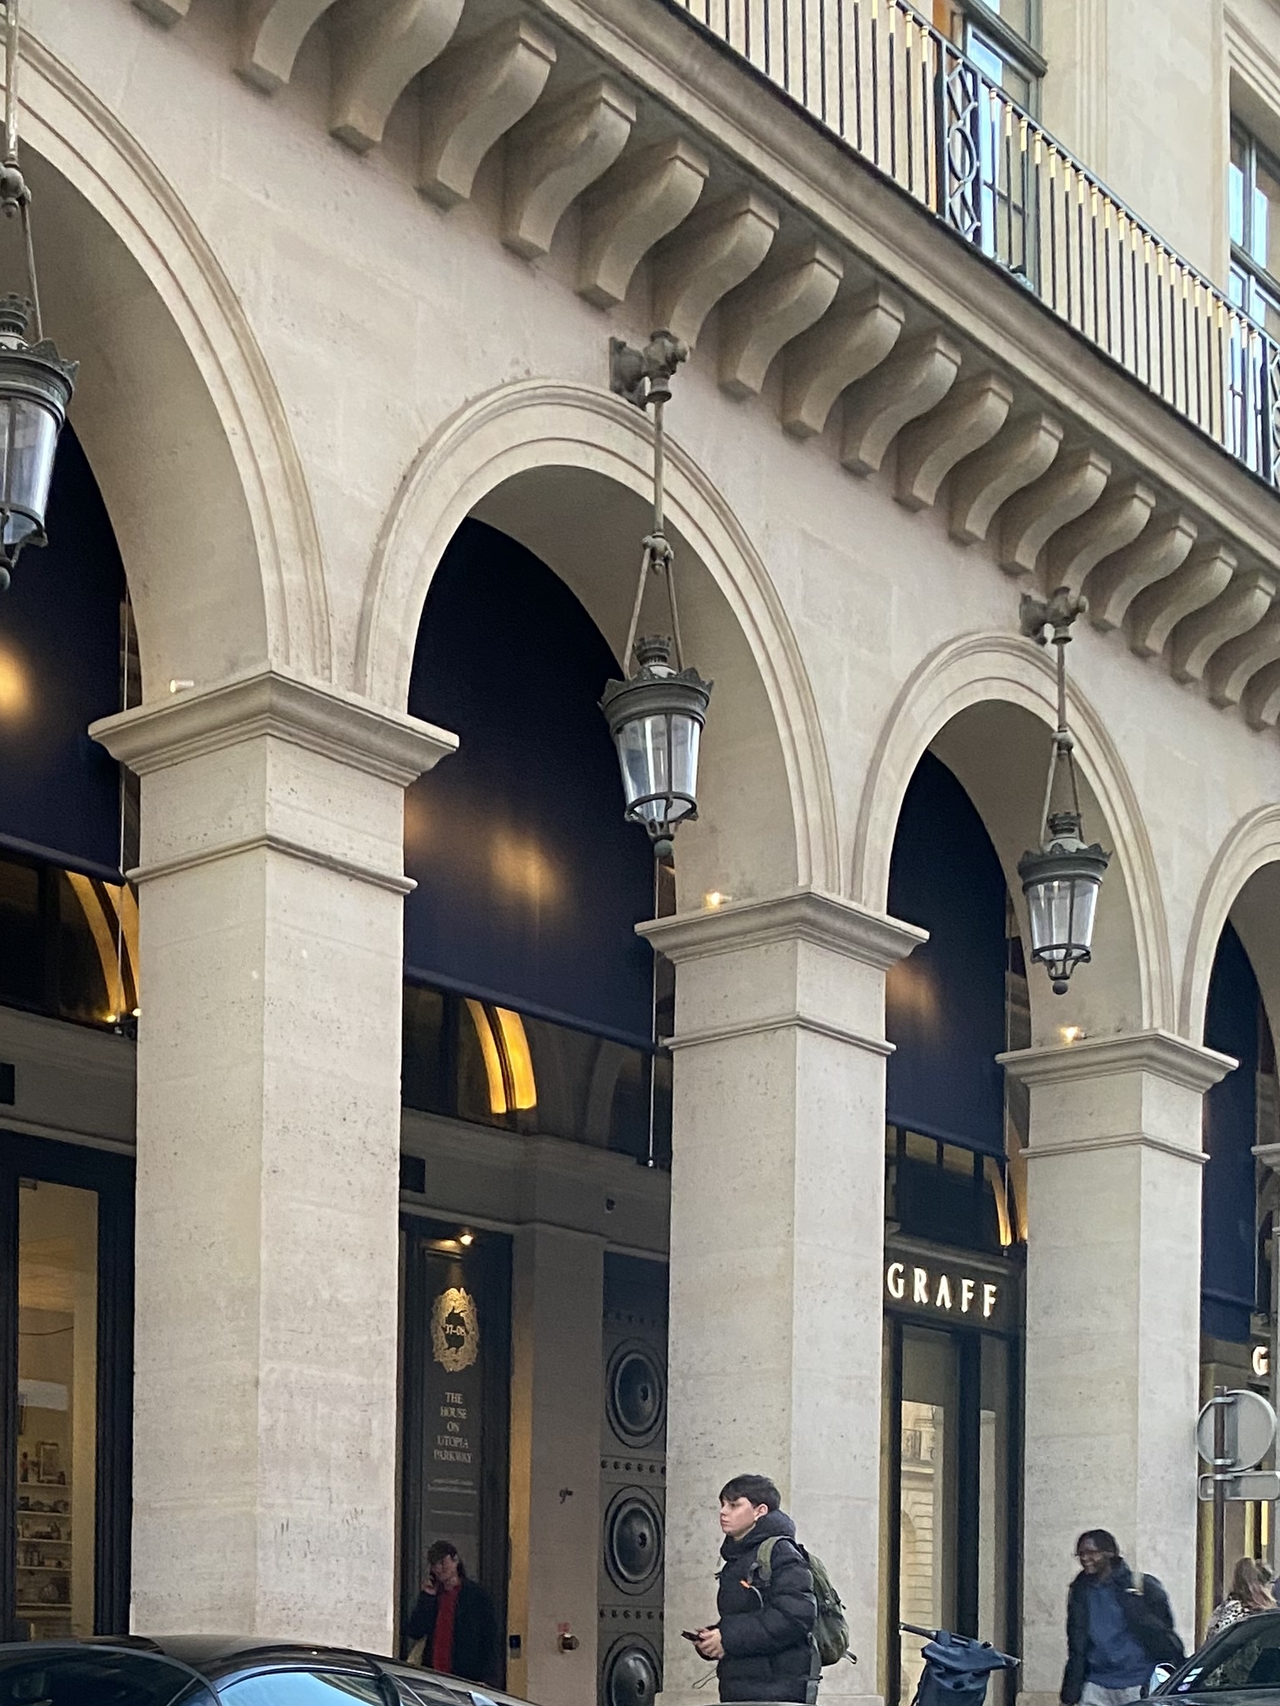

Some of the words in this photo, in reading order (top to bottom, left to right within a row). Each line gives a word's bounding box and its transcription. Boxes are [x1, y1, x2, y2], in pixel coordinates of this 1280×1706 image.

[887, 1262, 997, 1318] GRAFF
[445, 1392, 463, 1404] THE
[440, 1406, 468, 1419] HOUSE
[447, 1421, 460, 1433] ON
[437, 1435, 469, 1449] UTOPIA
[433, 1449, 472, 1463] PARKWAY
